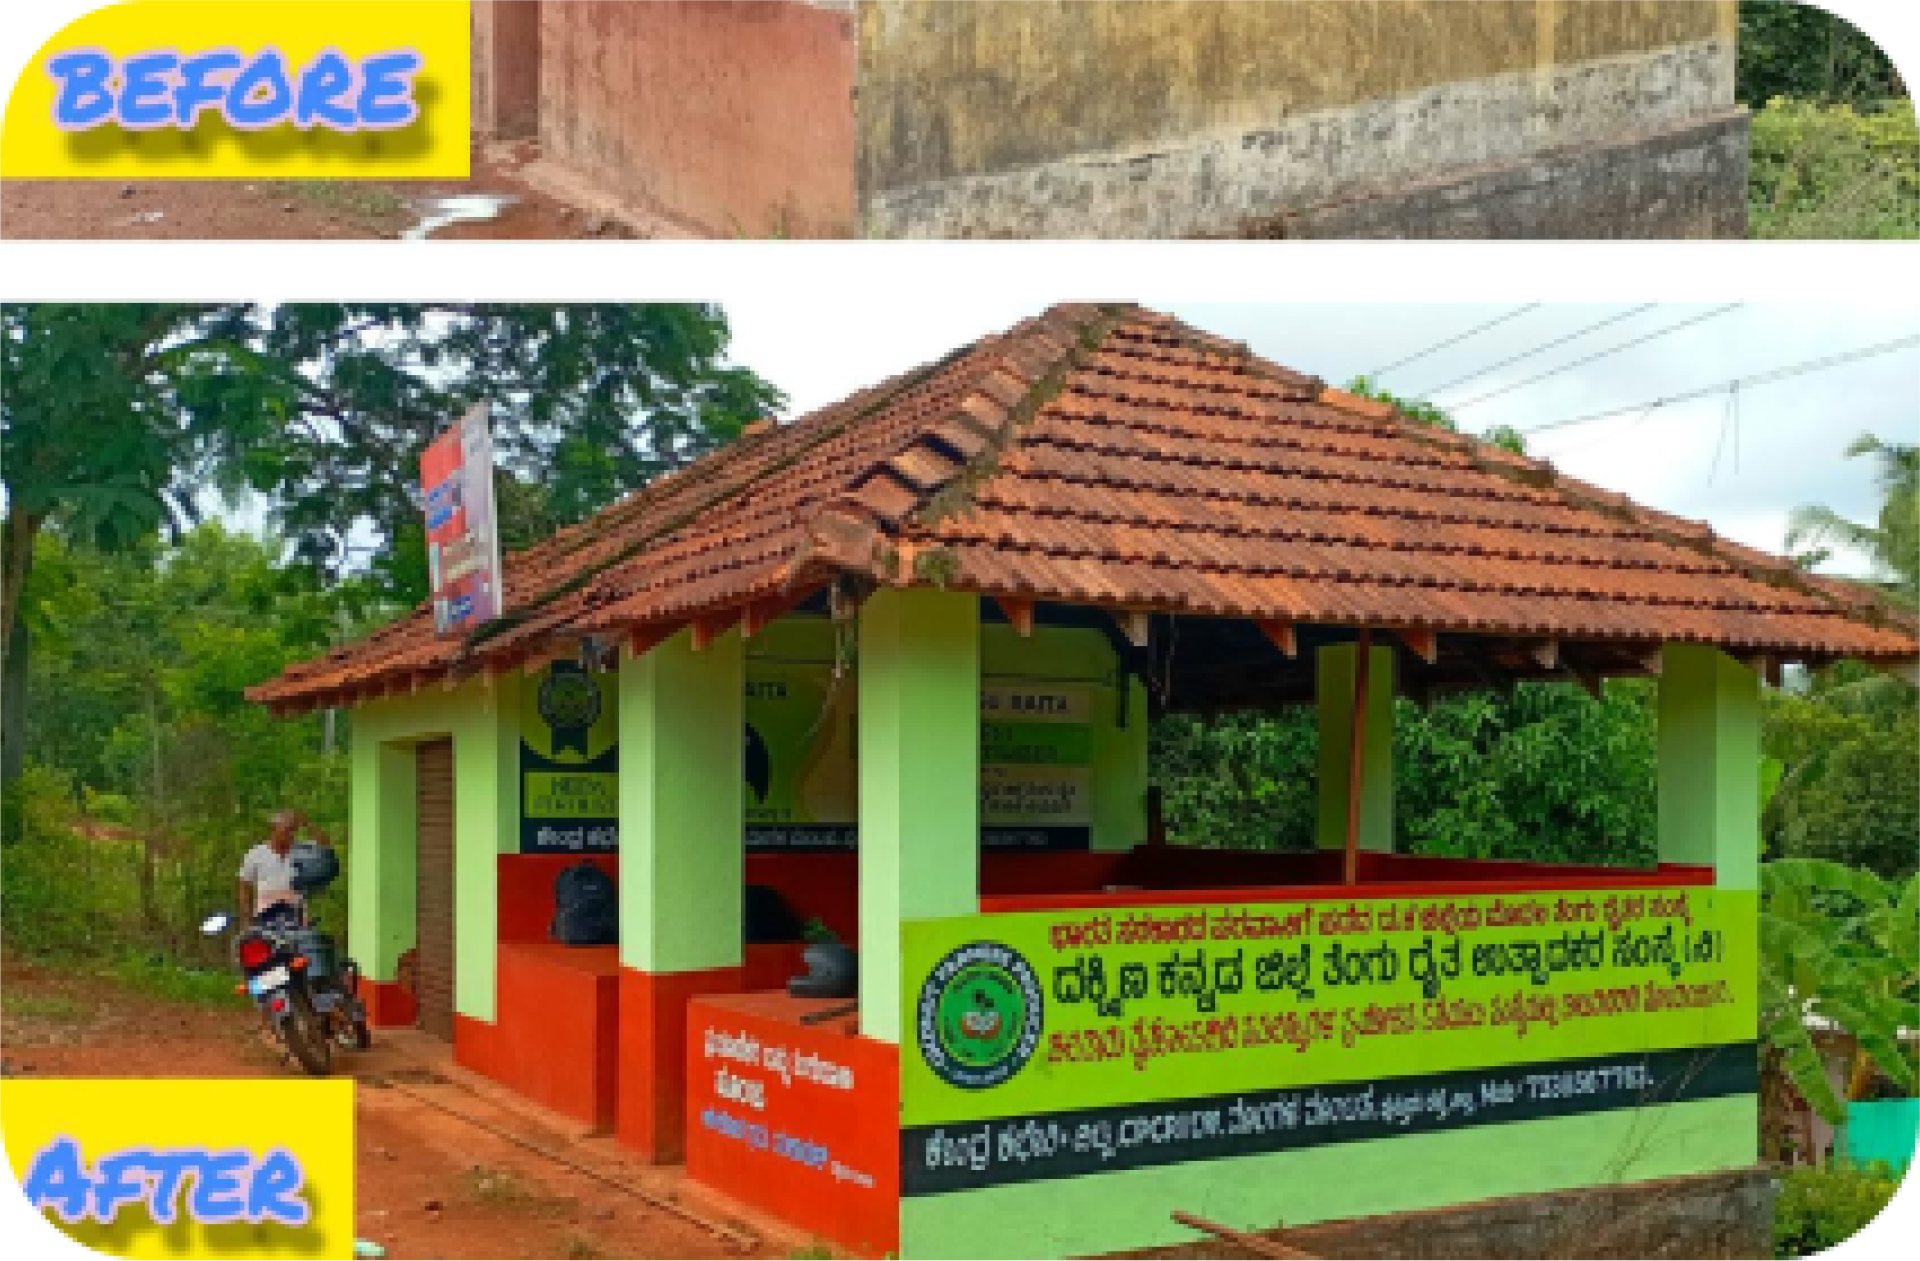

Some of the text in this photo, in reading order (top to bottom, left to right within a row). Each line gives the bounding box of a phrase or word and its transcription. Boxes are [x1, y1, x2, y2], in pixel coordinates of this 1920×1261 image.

[1051, 955, 1149, 1018] ದಕ್ಷಿಣ
[1156, 948, 1244, 1012] ಕನ್ನಡ
[1255, 943, 1316, 1003] ಜಿಲ್ಲೆ
[1322, 940, 1398, 986] ತೆಂಗು
[1409, 935, 1464, 999] ರೈತ
